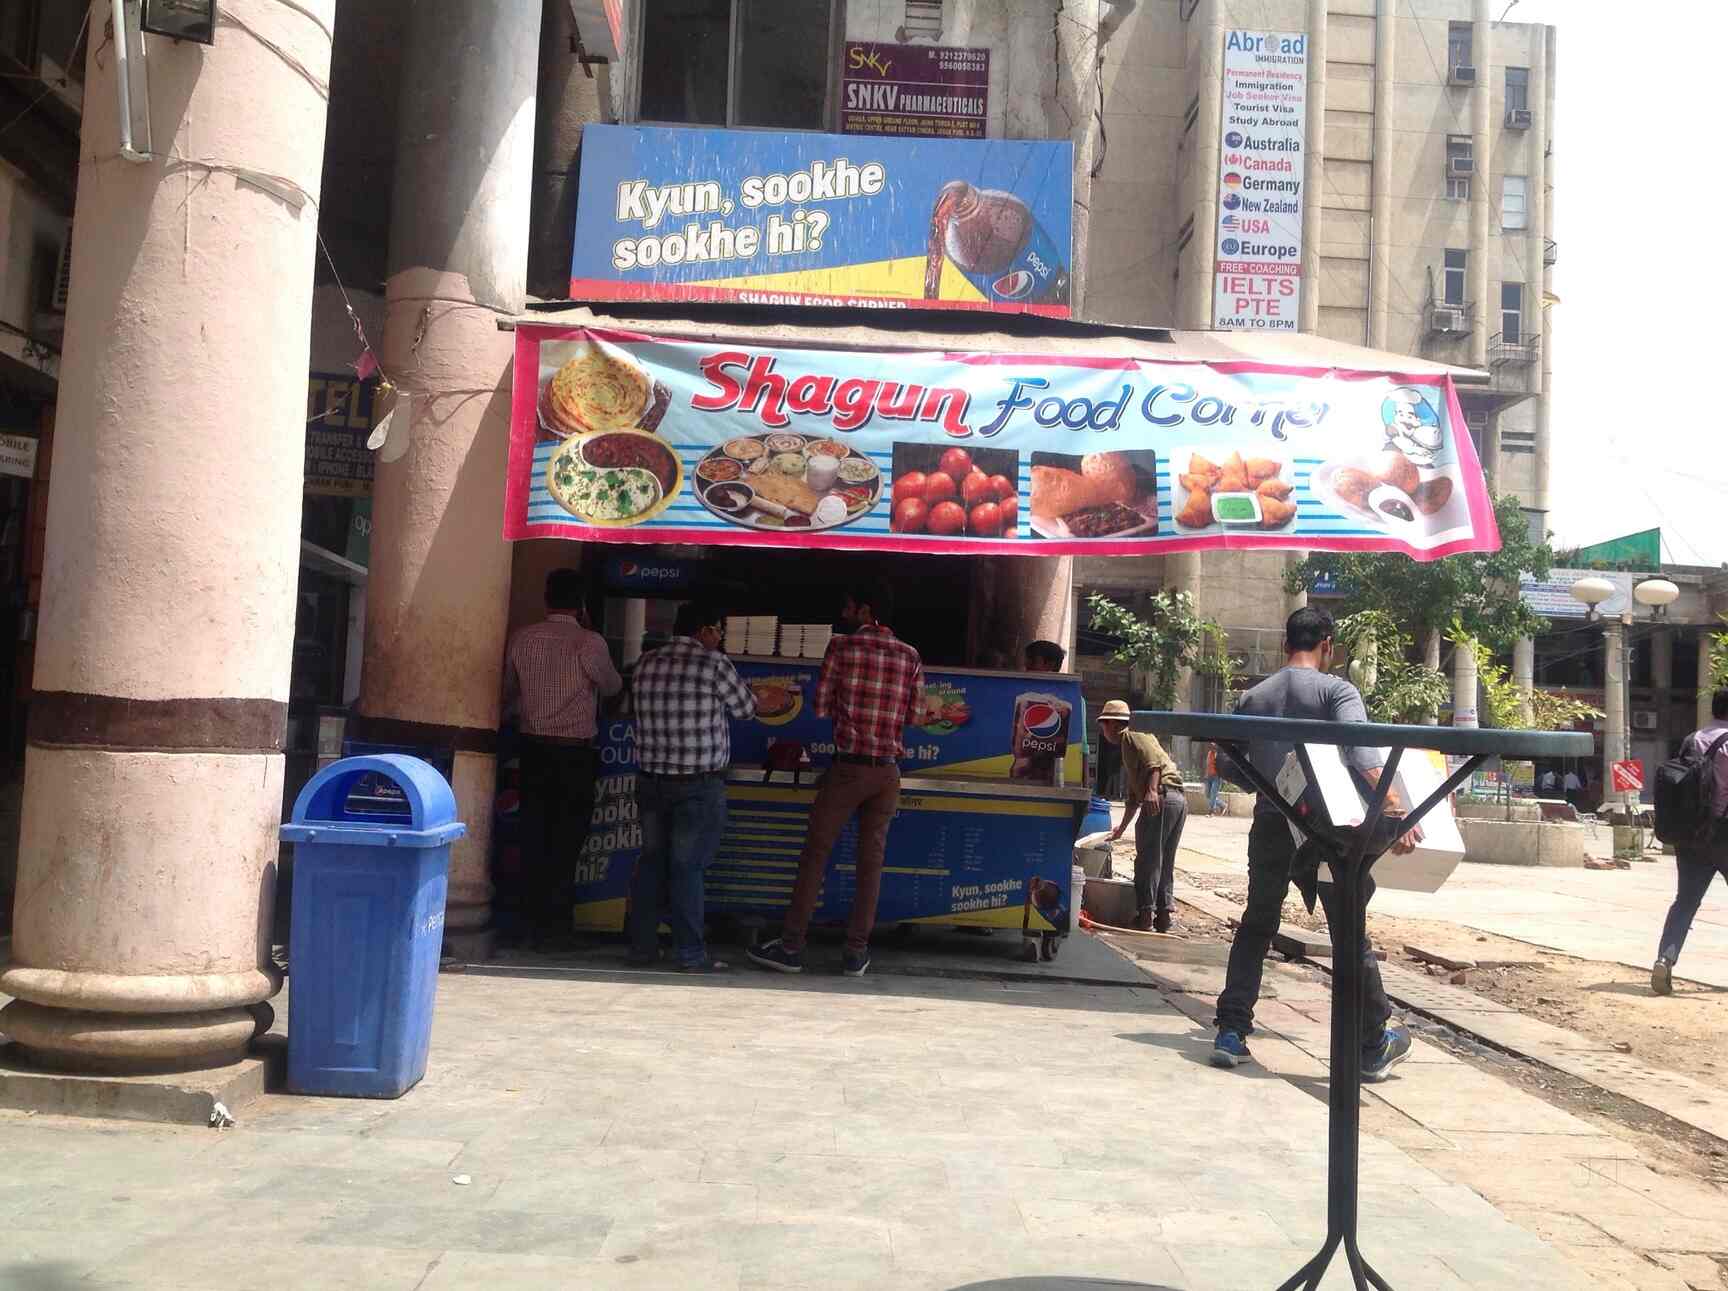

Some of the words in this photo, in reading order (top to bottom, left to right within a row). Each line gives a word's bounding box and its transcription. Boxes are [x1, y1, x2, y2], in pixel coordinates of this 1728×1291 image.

[1235, 80, 1294, 92] Immigration
[847, 83, 898, 110] SNKV
[900, 95, 983, 114] PHARMACEUTICALS
[1233, 103, 1269, 112] Tourist
[1272, 104, 1295, 113] Visa
[1229, 116, 1259, 127] Study
[1262, 118, 1299, 127] Abroad
[1243, 136, 1300, 152] Australia
[1243, 156, 1292, 172] Canada
[617, 180, 735, 228] Kyun,
[741, 159, 886, 208] sookhe
[1242, 176, 1300, 196] Germany
[1241, 197, 1261, 213] New
[1263, 199, 1298, 214] Zealand
[1241, 219, 1271, 234] USA
[613, 221, 760, 271] sookhe
[767, 209, 830, 256] hi?
[1240, 241, 1297, 260] Europe
[1026, 251, 1052, 280] pepsi
[1249, 263, 1297, 274] COACHING
[1223, 276, 1294, 297] IELTS
[1235, 298, 1281, 316] PTE
[1219, 318, 1245, 328] 8AM
[1249, 319, 1265, 328] TO
[1268, 320, 1294, 329] 8PM
[691, 350, 972, 437] Shagun
[979, 376, 1132, 437] Food
[641, 566, 680, 580] pepsi
[609, 724, 636, 742] CA
[918, 744, 940, 761] hi?
[1022, 736, 1058, 752] pepsi
[595, 775, 636, 804] yun
[952, 884, 983, 898] Kyun,
[984, 878, 1022, 893] sookhe
[951, 899, 989, 912] sookhe
[991, 893, 1008, 909] hi?
